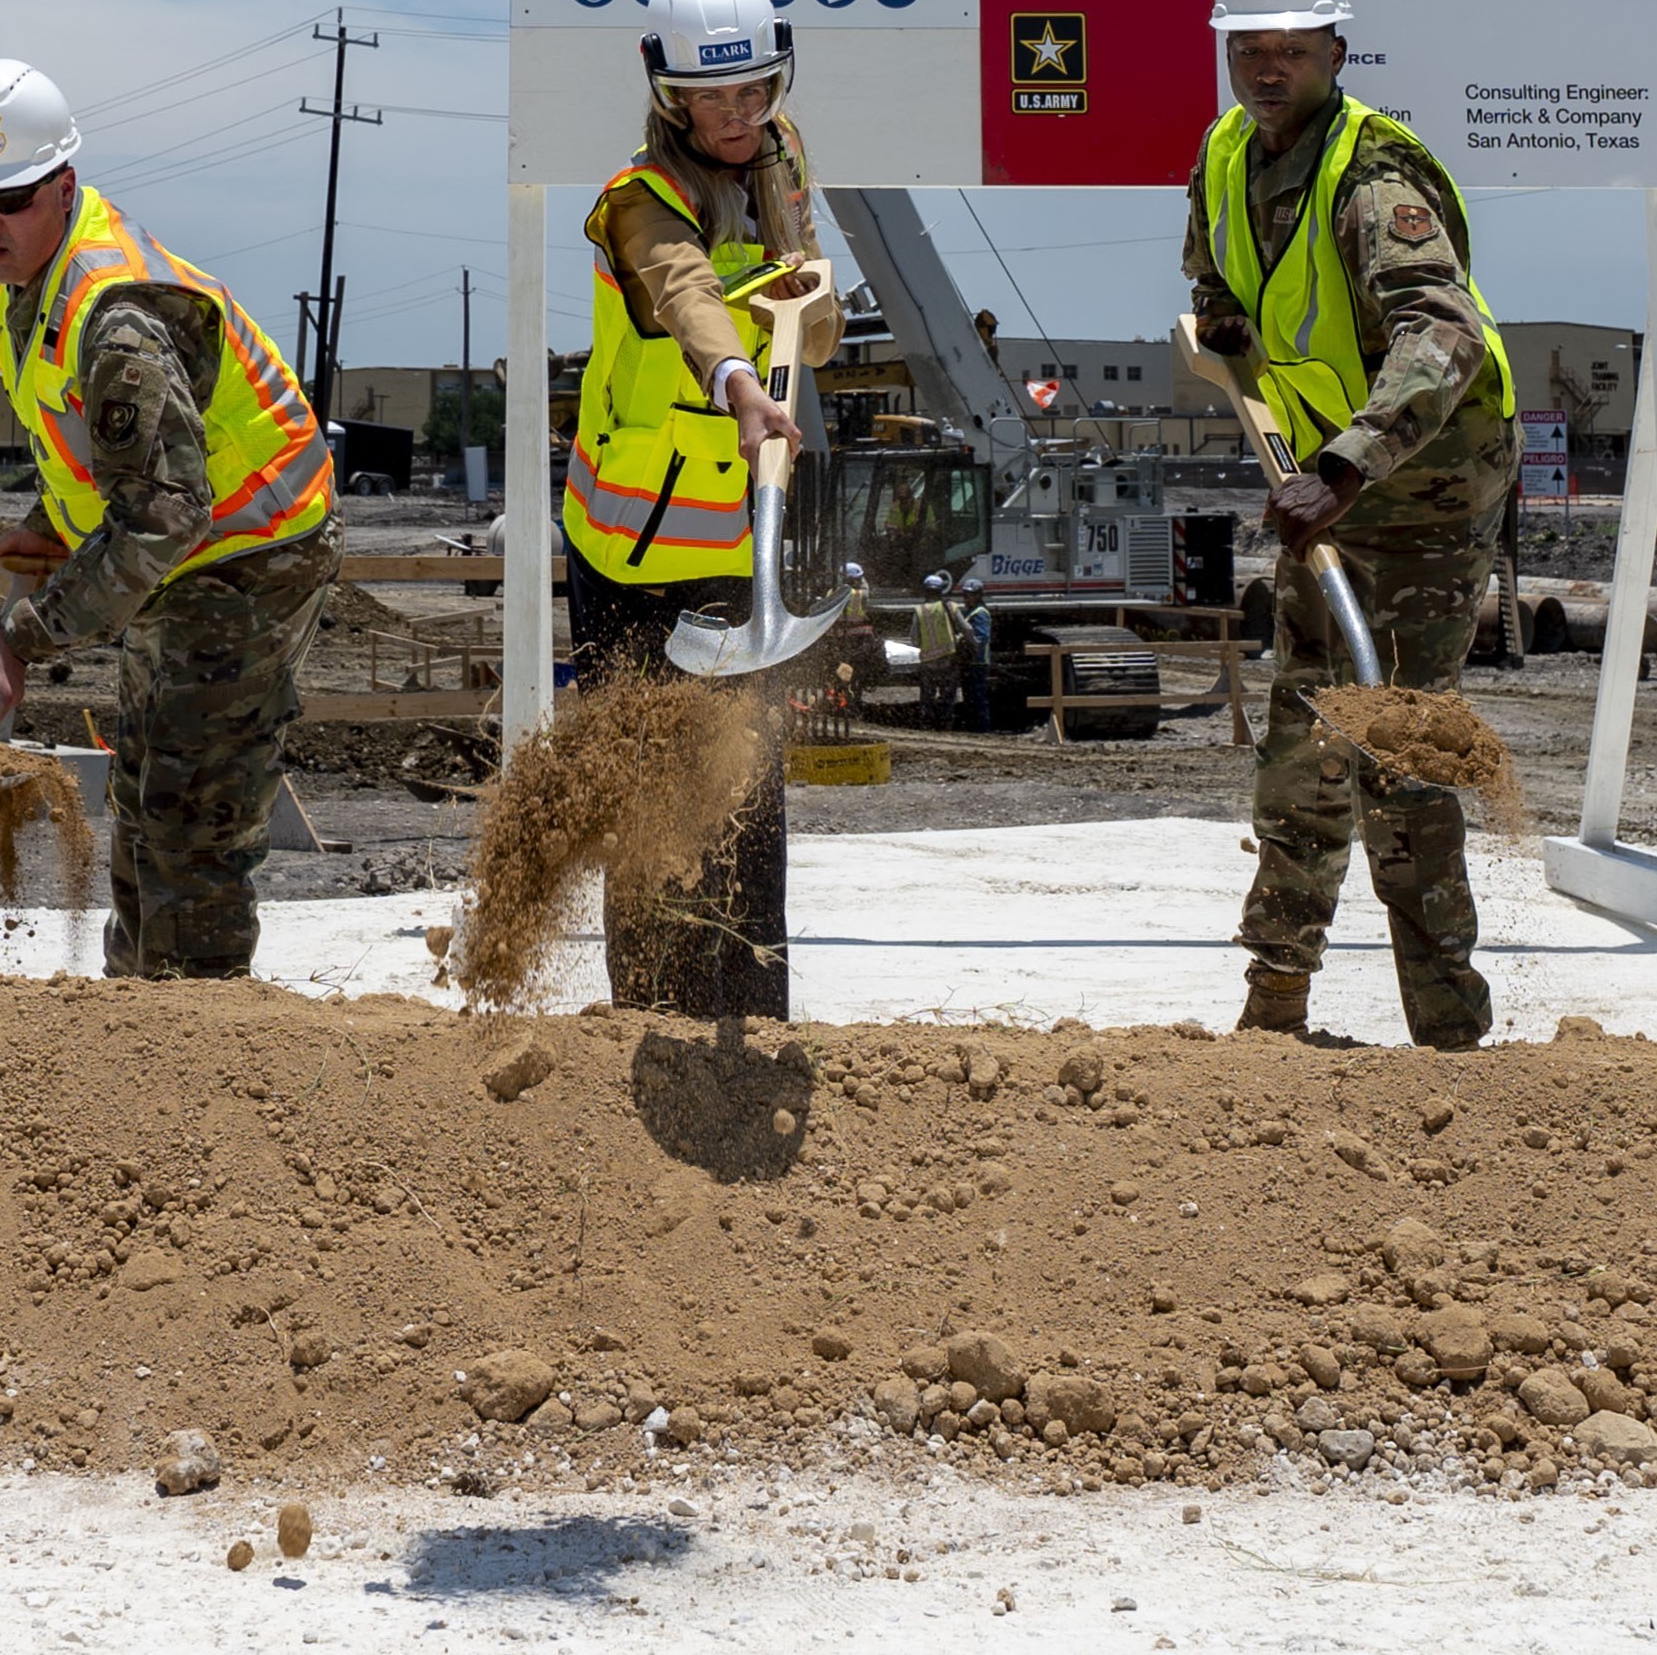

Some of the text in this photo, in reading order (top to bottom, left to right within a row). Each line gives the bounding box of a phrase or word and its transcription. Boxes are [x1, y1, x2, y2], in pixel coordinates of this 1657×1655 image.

[702, 43, 749, 59] CLARK
[1344, 53, 1387, 65] RCE
[1465, 84, 1648, 103] Consulting Engineer:
[1467, 108, 1642, 127] Merrick & Company
[1468, 133, 1639, 150] San Antonio, Texas
[1523, 412, 1563, 422] DANGER
[1523, 454, 1565, 463] PELIGRO
[1087, 525, 1119, 552] 750
